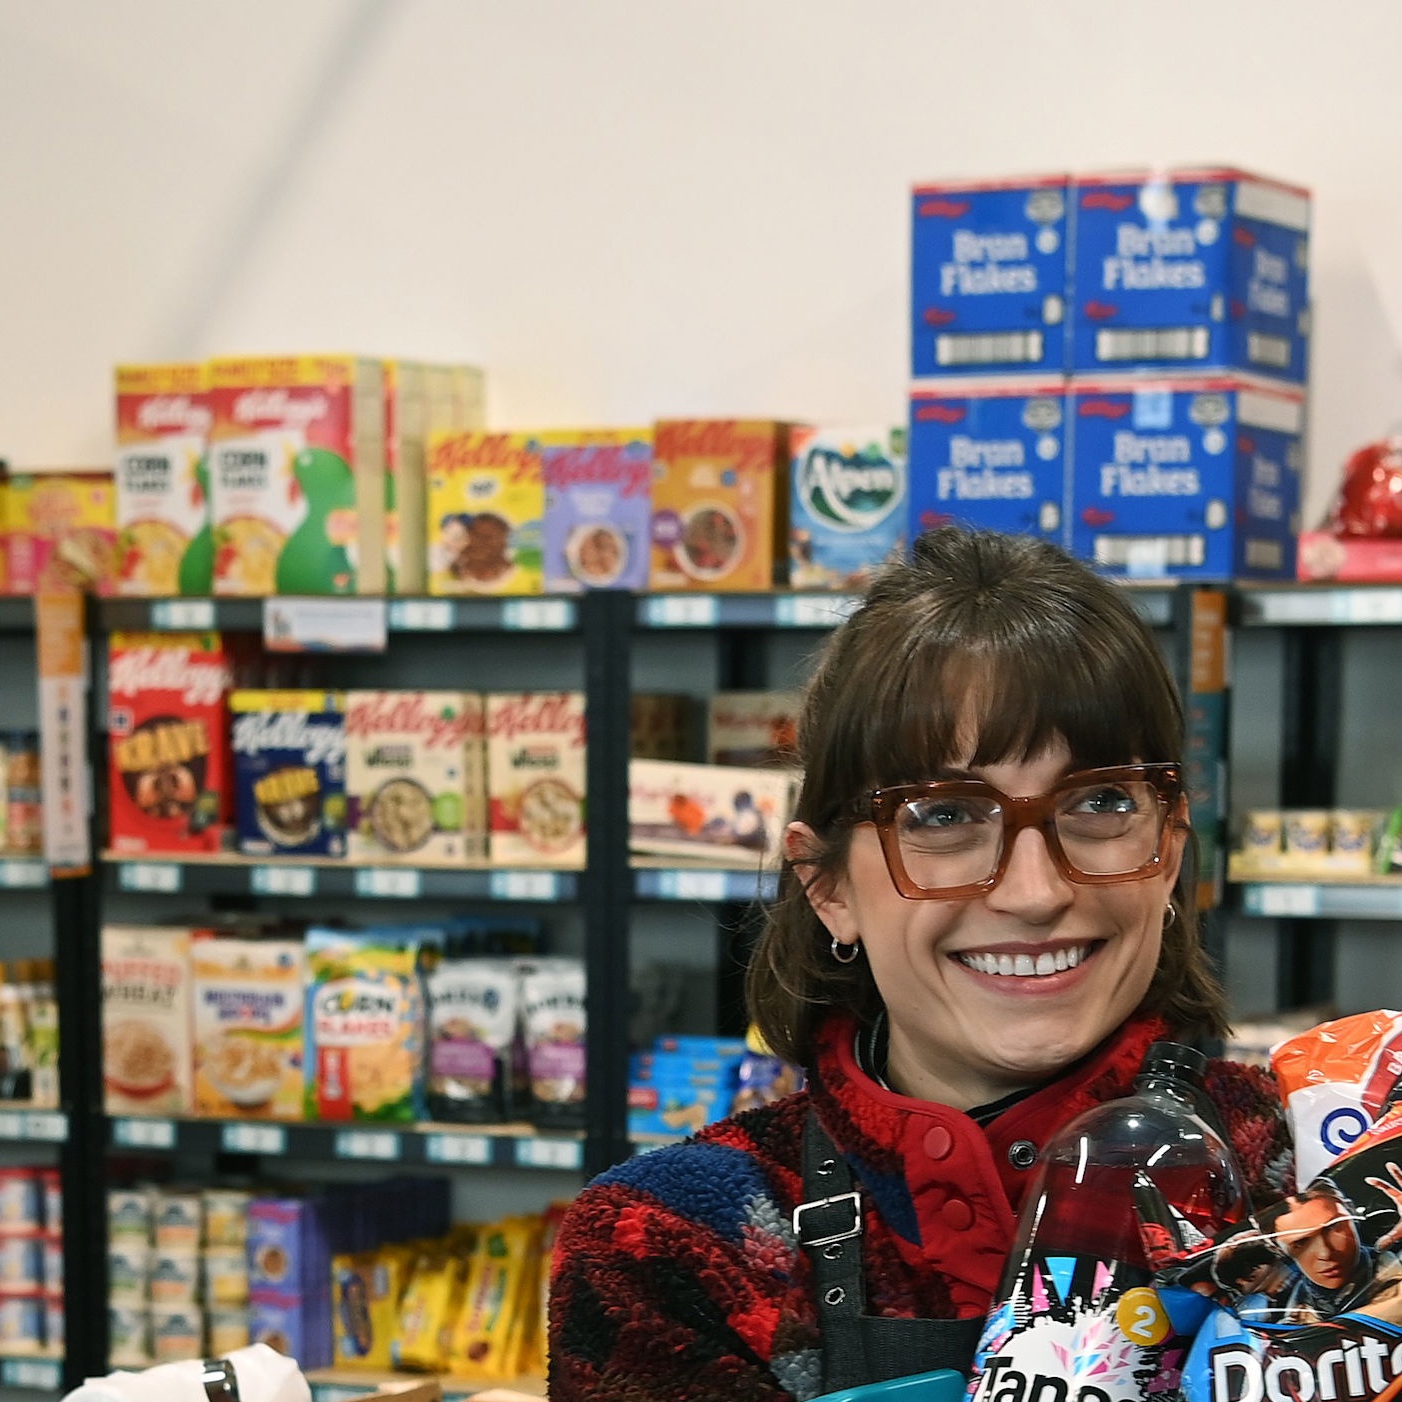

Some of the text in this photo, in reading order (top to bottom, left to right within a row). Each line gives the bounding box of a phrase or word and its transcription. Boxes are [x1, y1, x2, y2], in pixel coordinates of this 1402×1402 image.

[953, 229, 1028, 262] Bran
[1117, 223, 1195, 258] Bran
[941, 262, 1037, 295] Flakes
[1103, 256, 1205, 290] Flakes
[950, 435, 1025, 467] Bran
[1114, 430, 1191, 463] Bran
[937, 467, 1034, 500] Flakes
[1100, 463, 1198, 497] Flakes
[1129, 1305, 1157, 1339] 2
